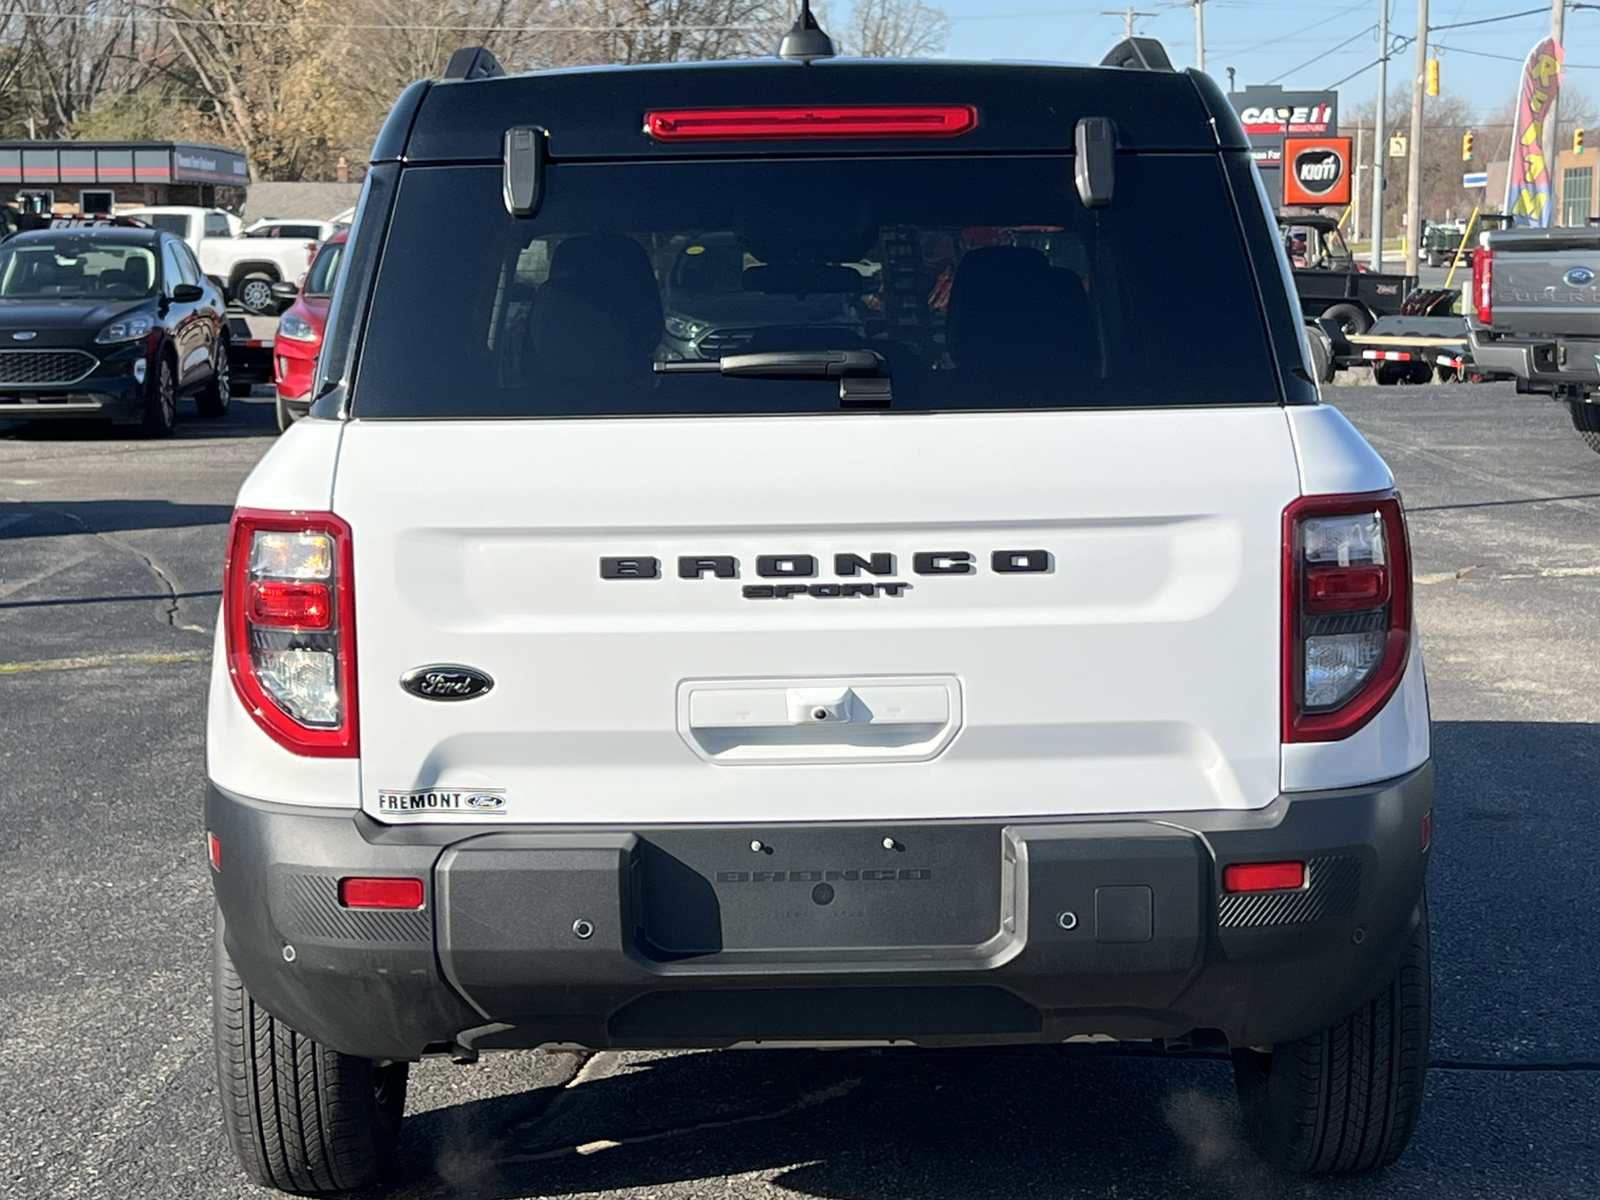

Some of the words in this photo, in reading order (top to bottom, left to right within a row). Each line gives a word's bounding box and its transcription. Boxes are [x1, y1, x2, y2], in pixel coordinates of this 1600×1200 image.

[1300, 163, 1336, 180] KIOTI
[600, 549, 1050, 579] BRONCO
[742, 582, 909, 598] SPORT
[421, 672, 471, 694] Ford
[379, 793, 461, 809] FREMONT
[715, 870, 931, 882] BRONCO
